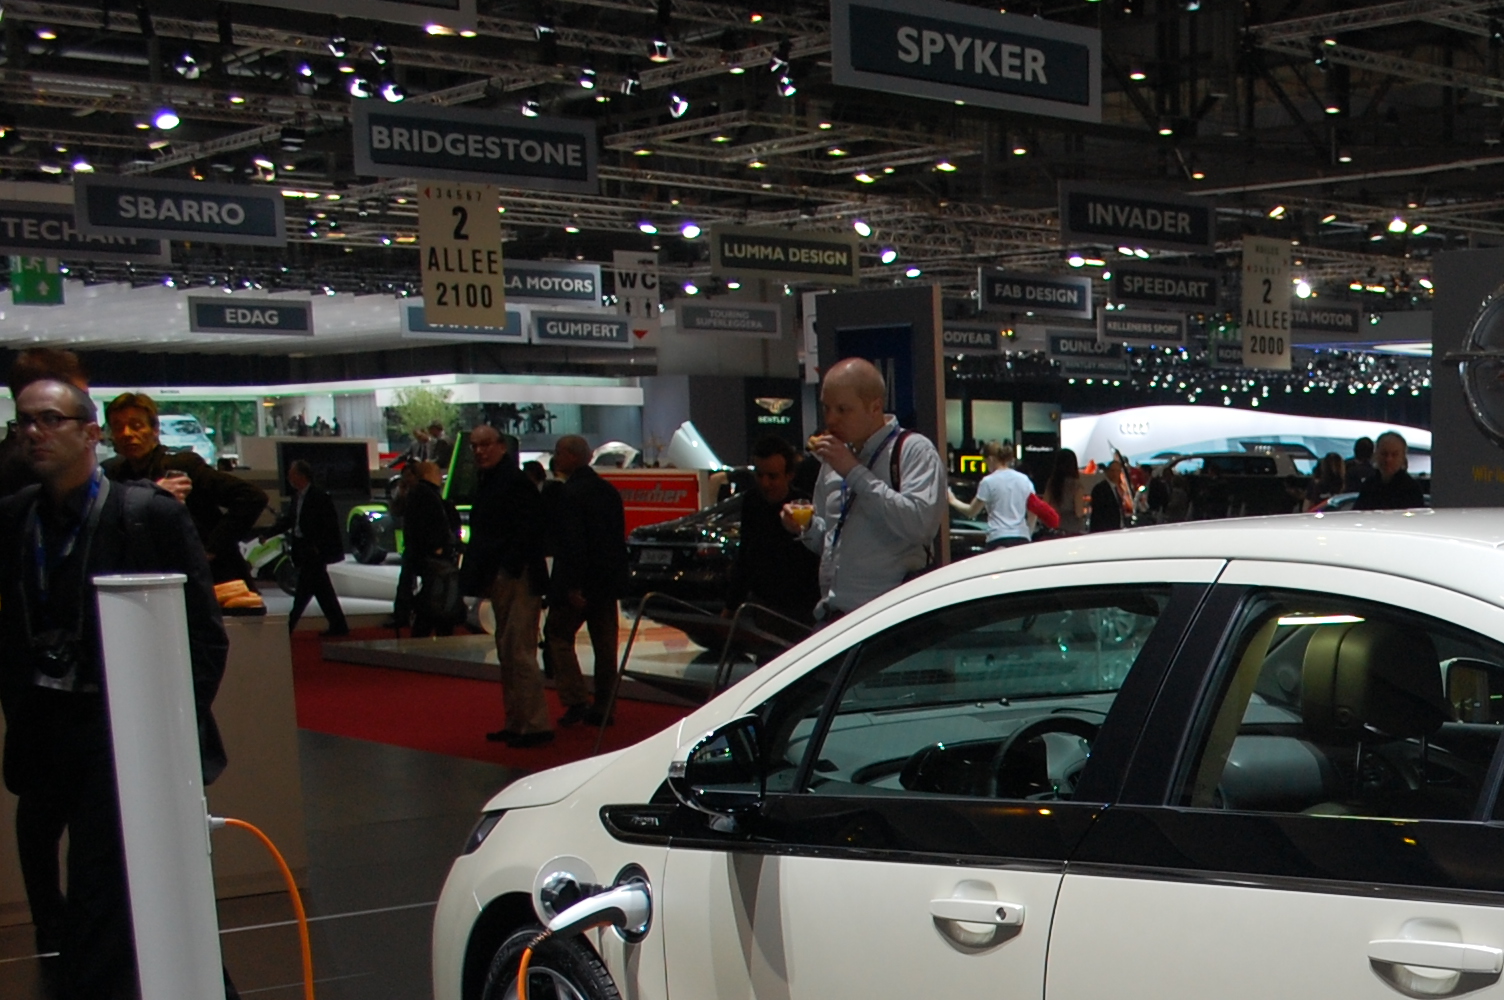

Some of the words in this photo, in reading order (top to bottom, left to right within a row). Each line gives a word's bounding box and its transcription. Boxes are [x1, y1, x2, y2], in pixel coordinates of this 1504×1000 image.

[897, 26, 1048, 84] SPYKER
[371, 125, 582, 167] BRIDGESTONE
[119, 195, 246, 226] SBARRO
[1088, 202, 1191, 234] INVADER
[452, 206, 469, 240] 2
[428, 246, 498, 275] ALLEE
[723, 242, 785, 261] LUMMA
[788, 247, 848, 266] DESIGN
[526, 277, 593, 293] MOTORS
[618, 273, 656, 290] WC
[1123, 275, 1209, 298] SPEEDART
[1262, 279, 1272, 304] 2
[436, 282, 493, 308] 2100
[994, 283, 1021, 299] FAB
[1026, 286, 1079, 304] DESIGN
[225, 308, 279, 325] EDAG
[696, 318, 763, 329] SUPERLEGGERA
[709, 309, 750, 319] TOURING
[1246, 309, 1288, 330] ALLEE
[546, 321, 619, 338] GUMPERT
[1153, 323, 1178, 334] SPORT
[1250, 336, 1284, 355] 2000
[1472, 465, 1494, 482] Wir
